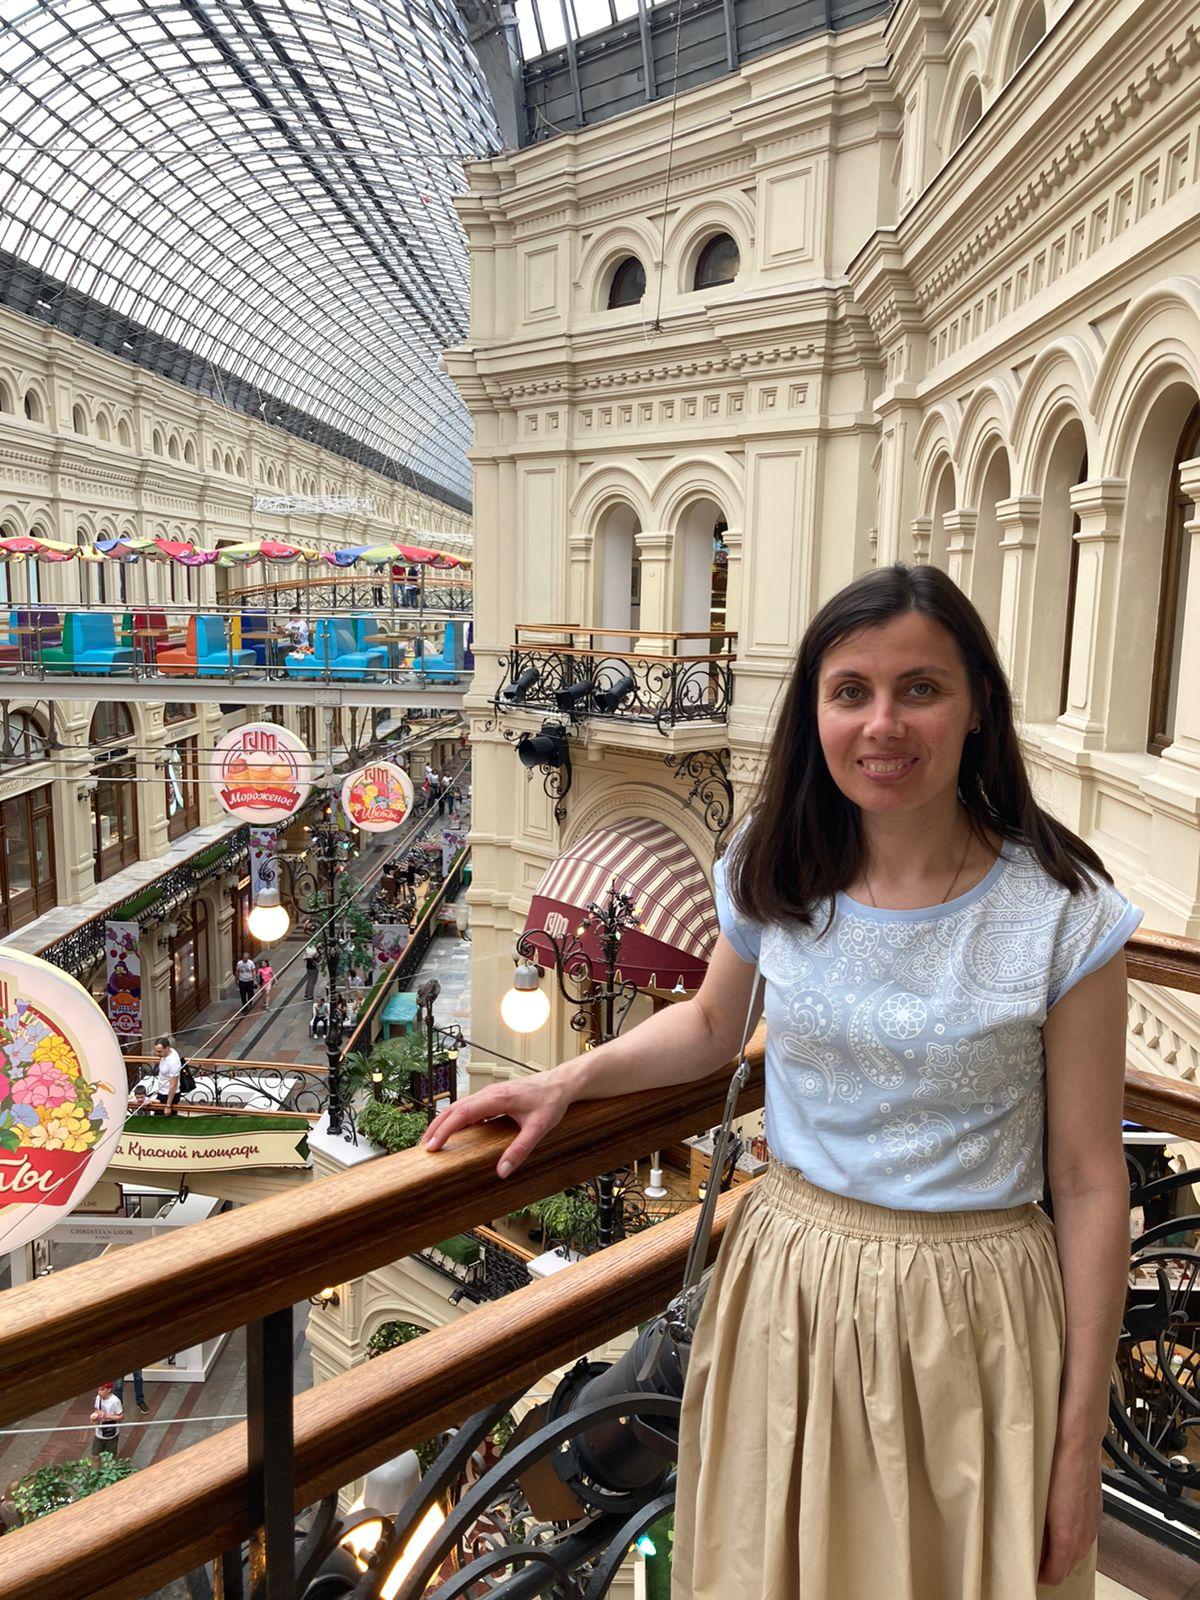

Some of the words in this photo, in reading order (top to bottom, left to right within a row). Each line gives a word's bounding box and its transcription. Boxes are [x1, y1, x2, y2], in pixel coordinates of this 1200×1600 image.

[229, 792, 294, 805] Мороженое
[128, 1141, 188, 1161] Красной
[191, 1145, 260, 1159] площади
